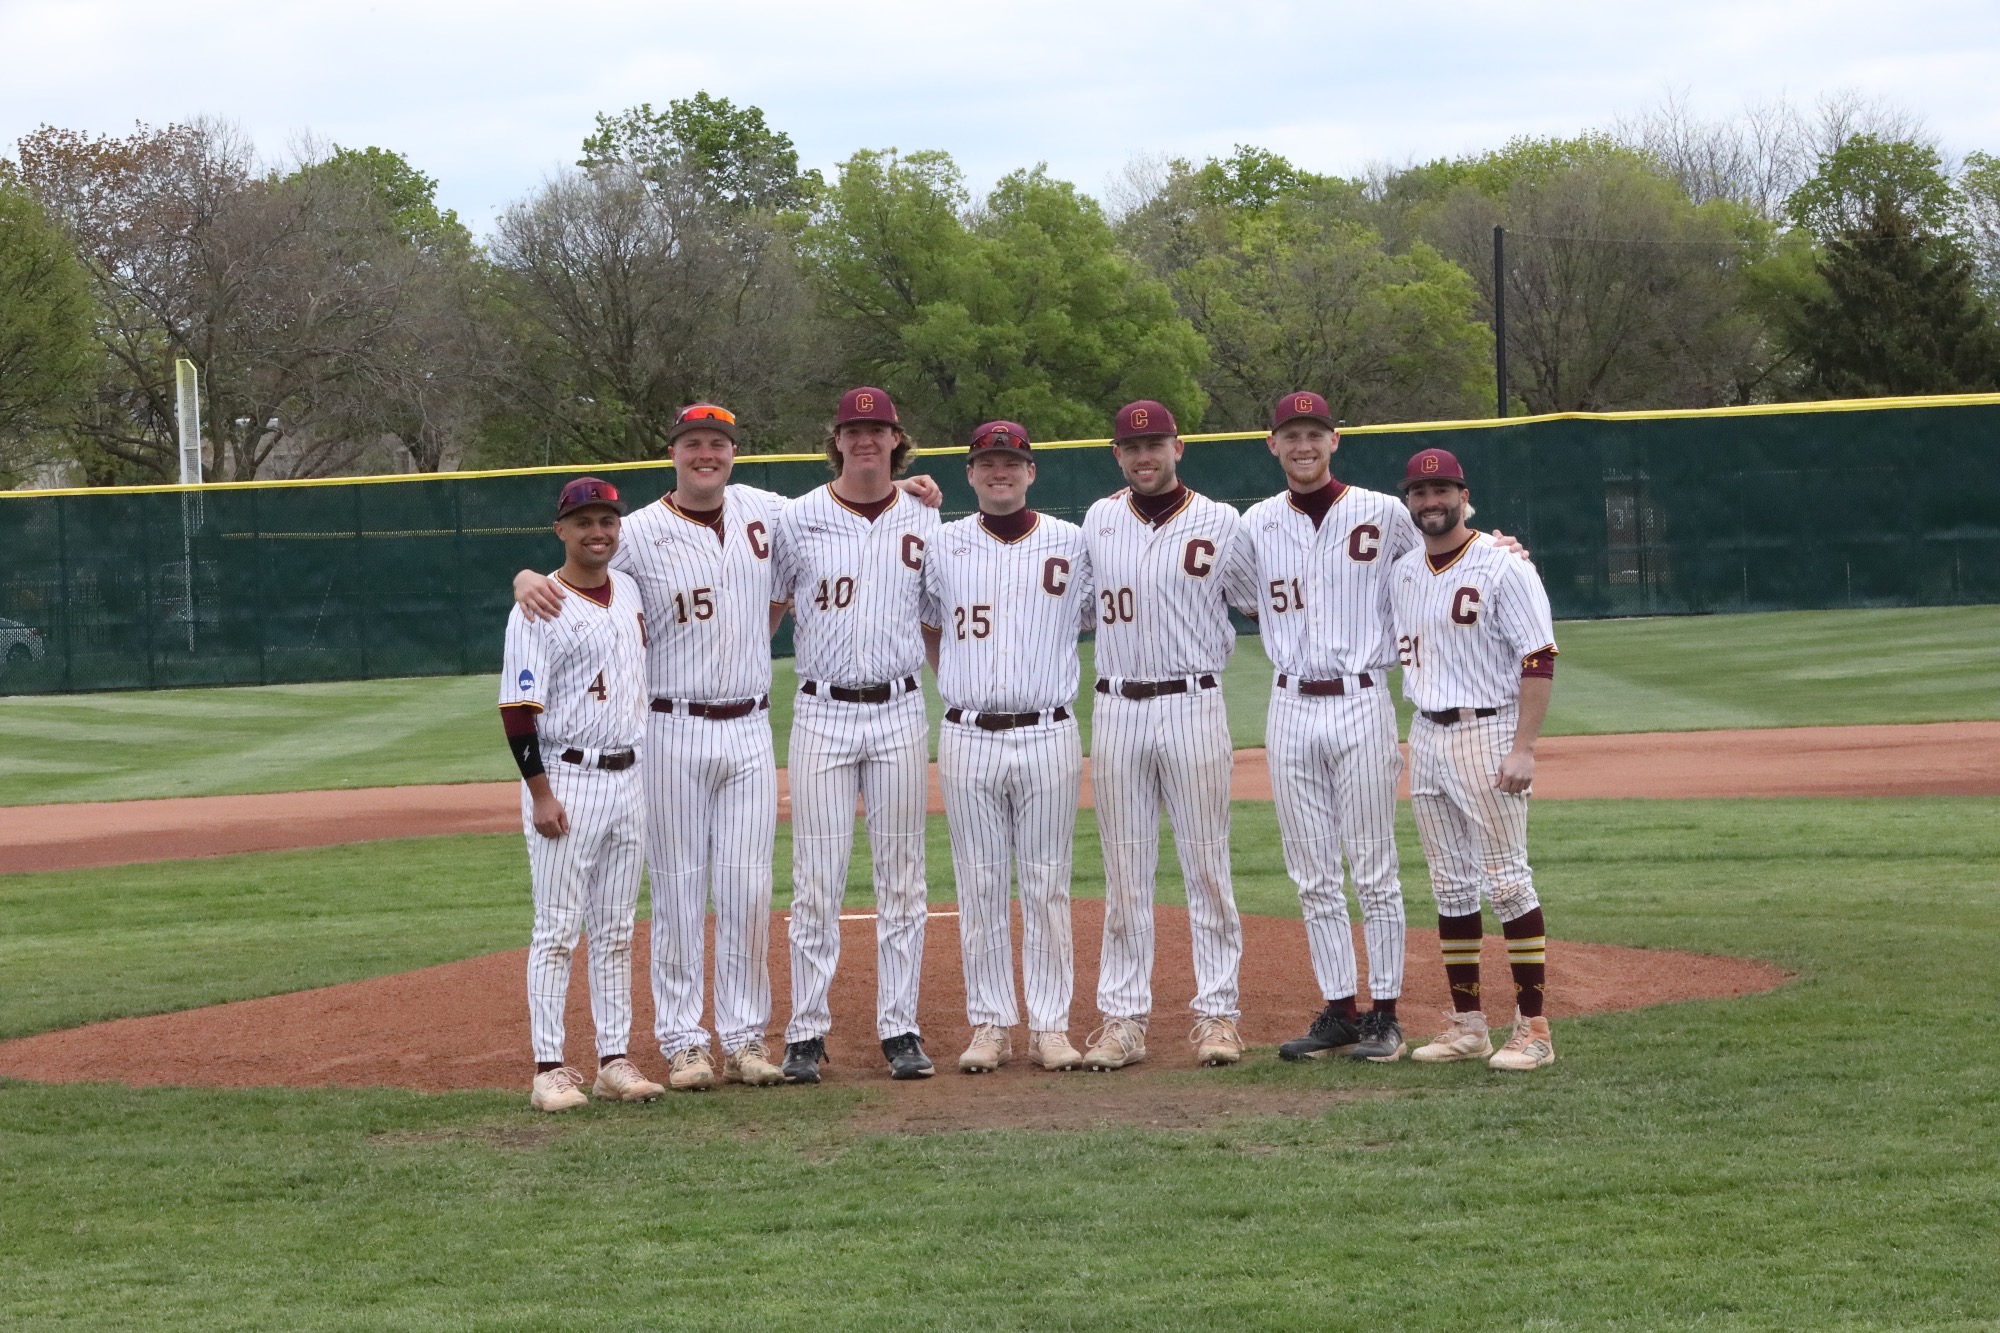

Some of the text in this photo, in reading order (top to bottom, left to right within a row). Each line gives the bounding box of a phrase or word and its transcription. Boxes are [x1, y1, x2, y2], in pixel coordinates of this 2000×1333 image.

[856, 394, 873, 412] C
[1131, 409, 1148, 429] C
[1294, 396, 1312, 412] C
[1421, 455, 1438, 473] C
[746, 520, 770, 561] C
[900, 532, 924, 572] C
[1183, 537, 1215, 579] C
[1347, 523, 1380, 563] C
[814, 575, 855, 612] 40
[1042, 555, 1070, 598] C
[1268, 576, 1305, 614] 51
[673, 586, 715, 624] 15
[954, 604, 992, 641] 25
[1099, 586, 1135, 626] 30
[1450, 585, 1481, 626] C
[1398, 634, 1421, 668] 21
[587, 668, 608, 702] 4
